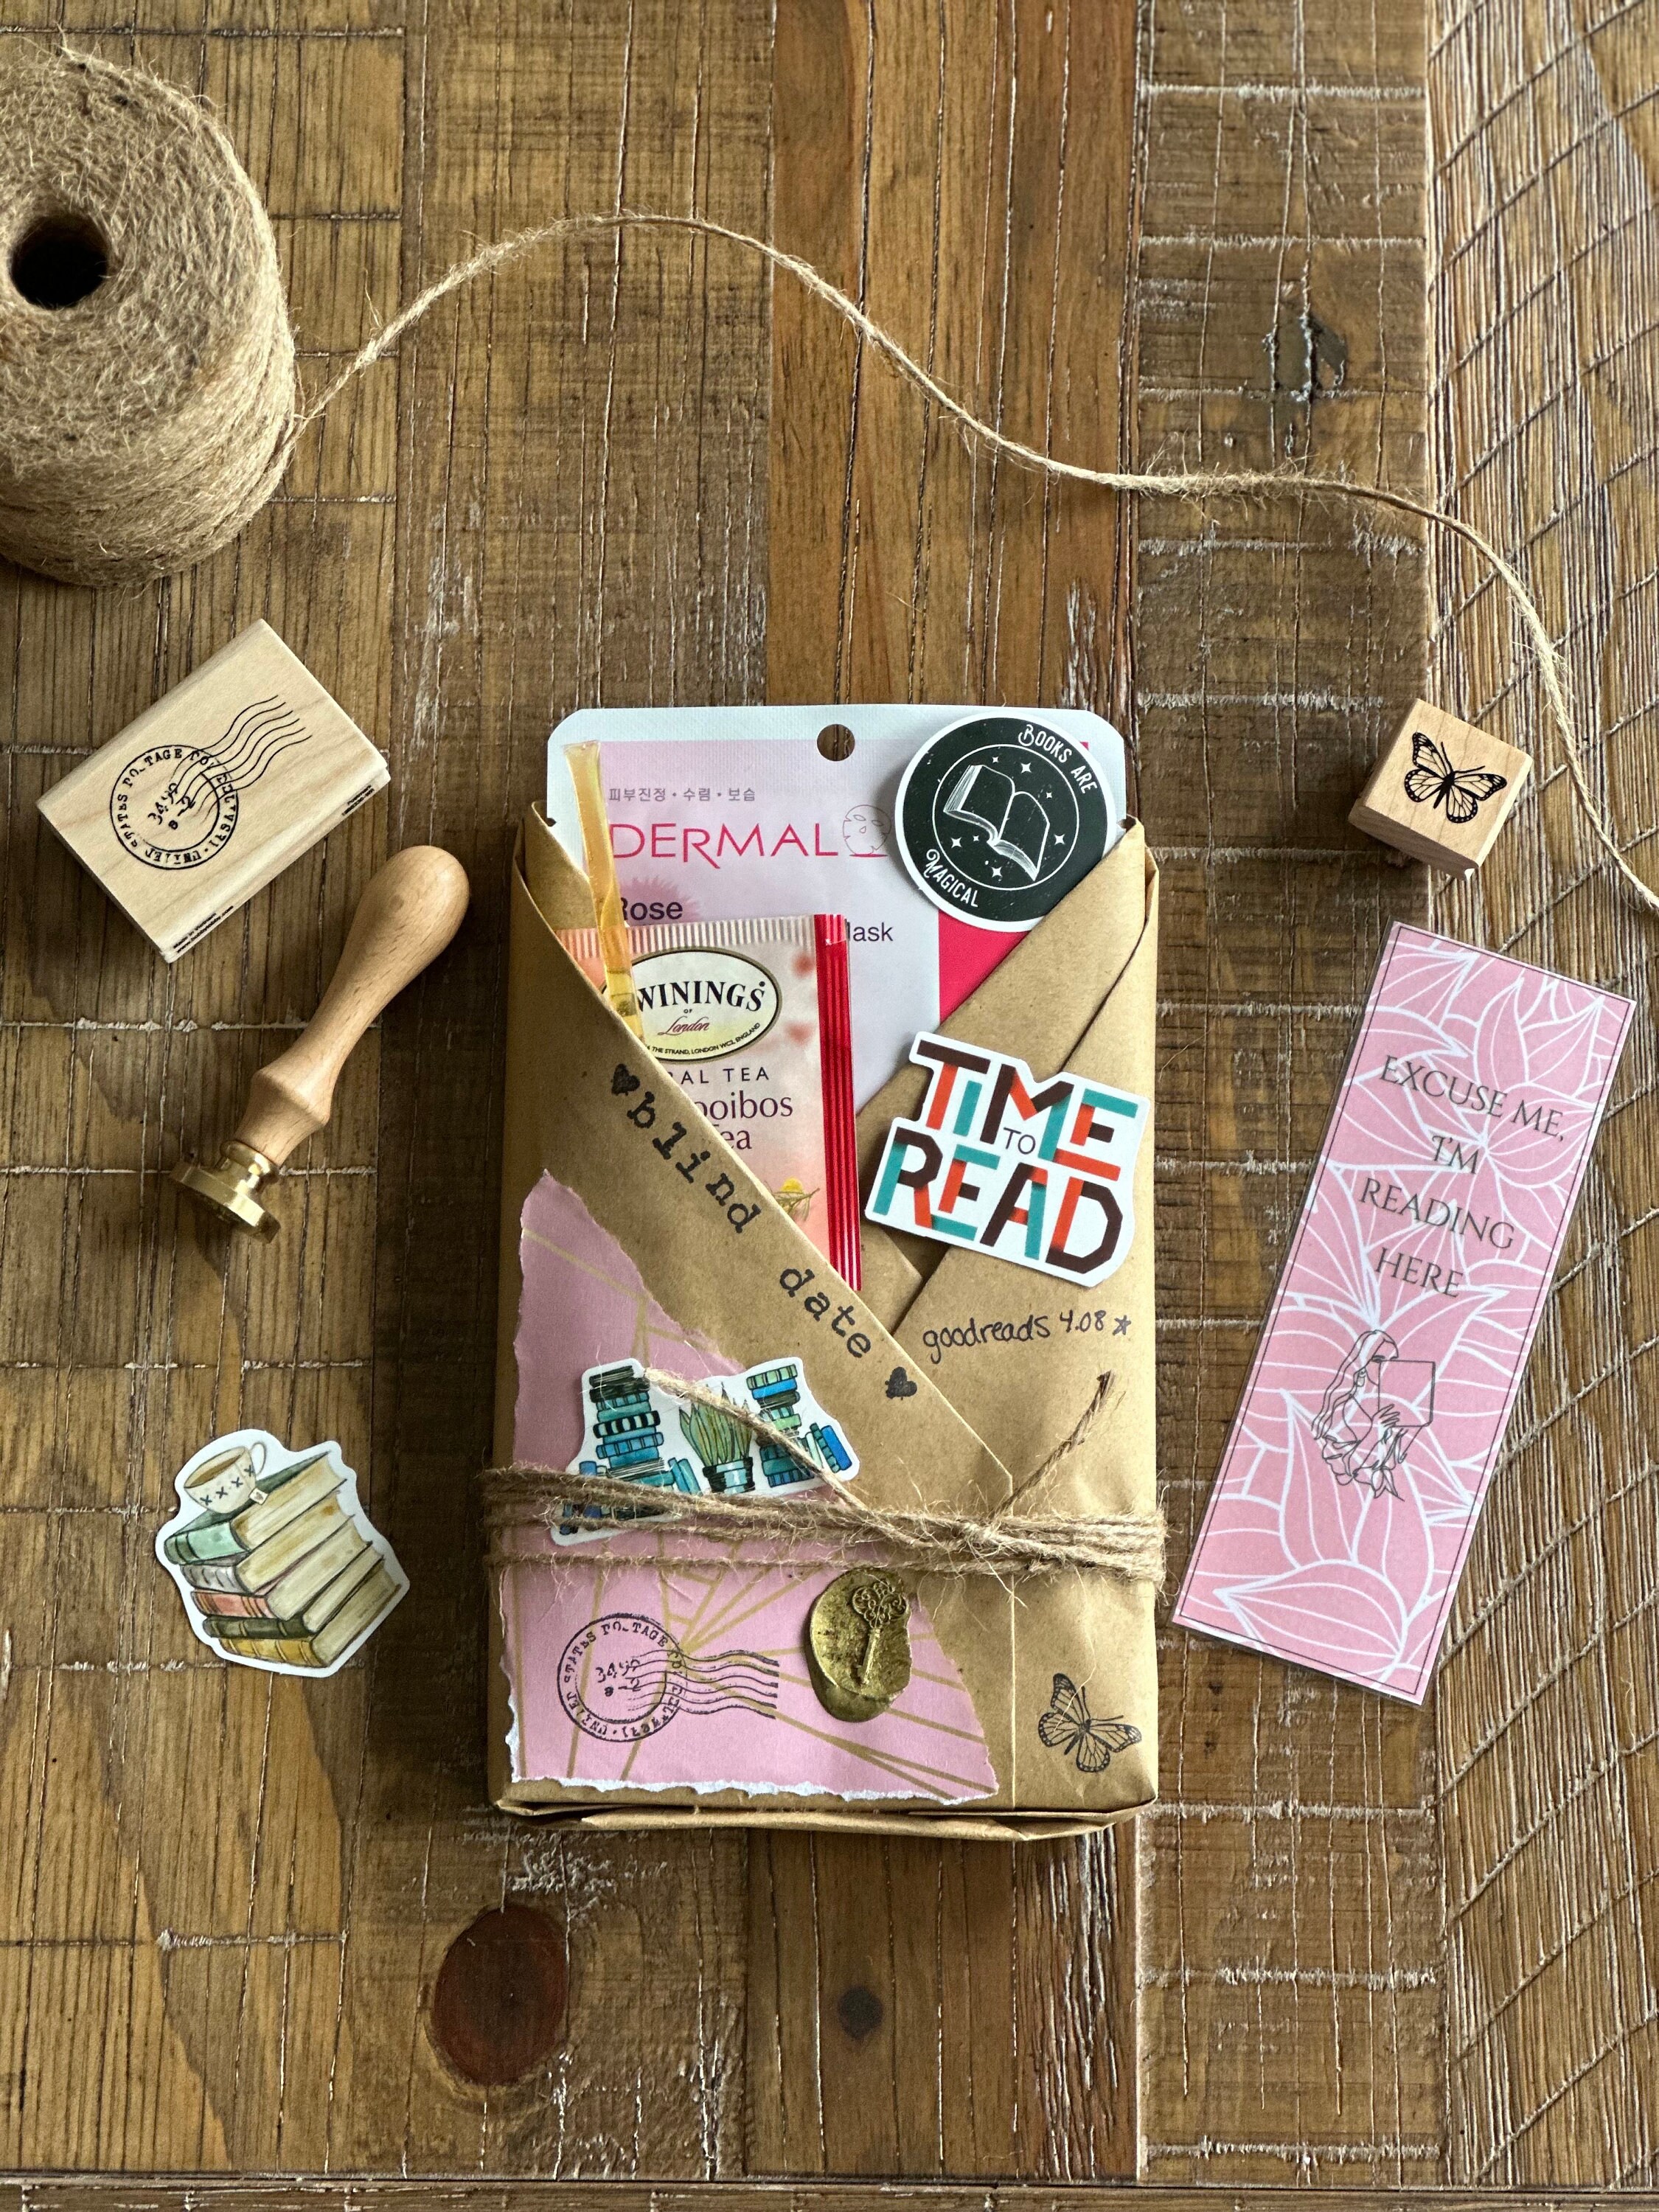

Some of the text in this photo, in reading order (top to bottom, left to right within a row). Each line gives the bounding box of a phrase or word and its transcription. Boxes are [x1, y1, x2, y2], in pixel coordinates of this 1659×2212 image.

[1018, 724, 1097, 794] BOOKS ARE
[609, 787, 755, 801] 피부진정 수렴 보습
[609, 823, 838, 869] DERMAL
[923, 848, 978, 908] MAGICAL
[846, 922, 893, 942] ask
[658, 1016, 710, 1036] London
[723, 1067, 769, 1082] TEA
[1379, 1054, 1565, 1142] EXCUSE ME,
[917, 1040, 1138, 1182] TIME
[1004, 1127, 1036, 1155] TO
[1431, 1134, 1481, 1175] I'M
[627, 1091, 872, 1358] blind date
[872, 1127, 1123, 1275] READ
[1358, 1177, 1514, 1251] READING
[1375, 1246, 1465, 1299] HERE
[922, 1309, 1105, 1365] goodreads 4.08
